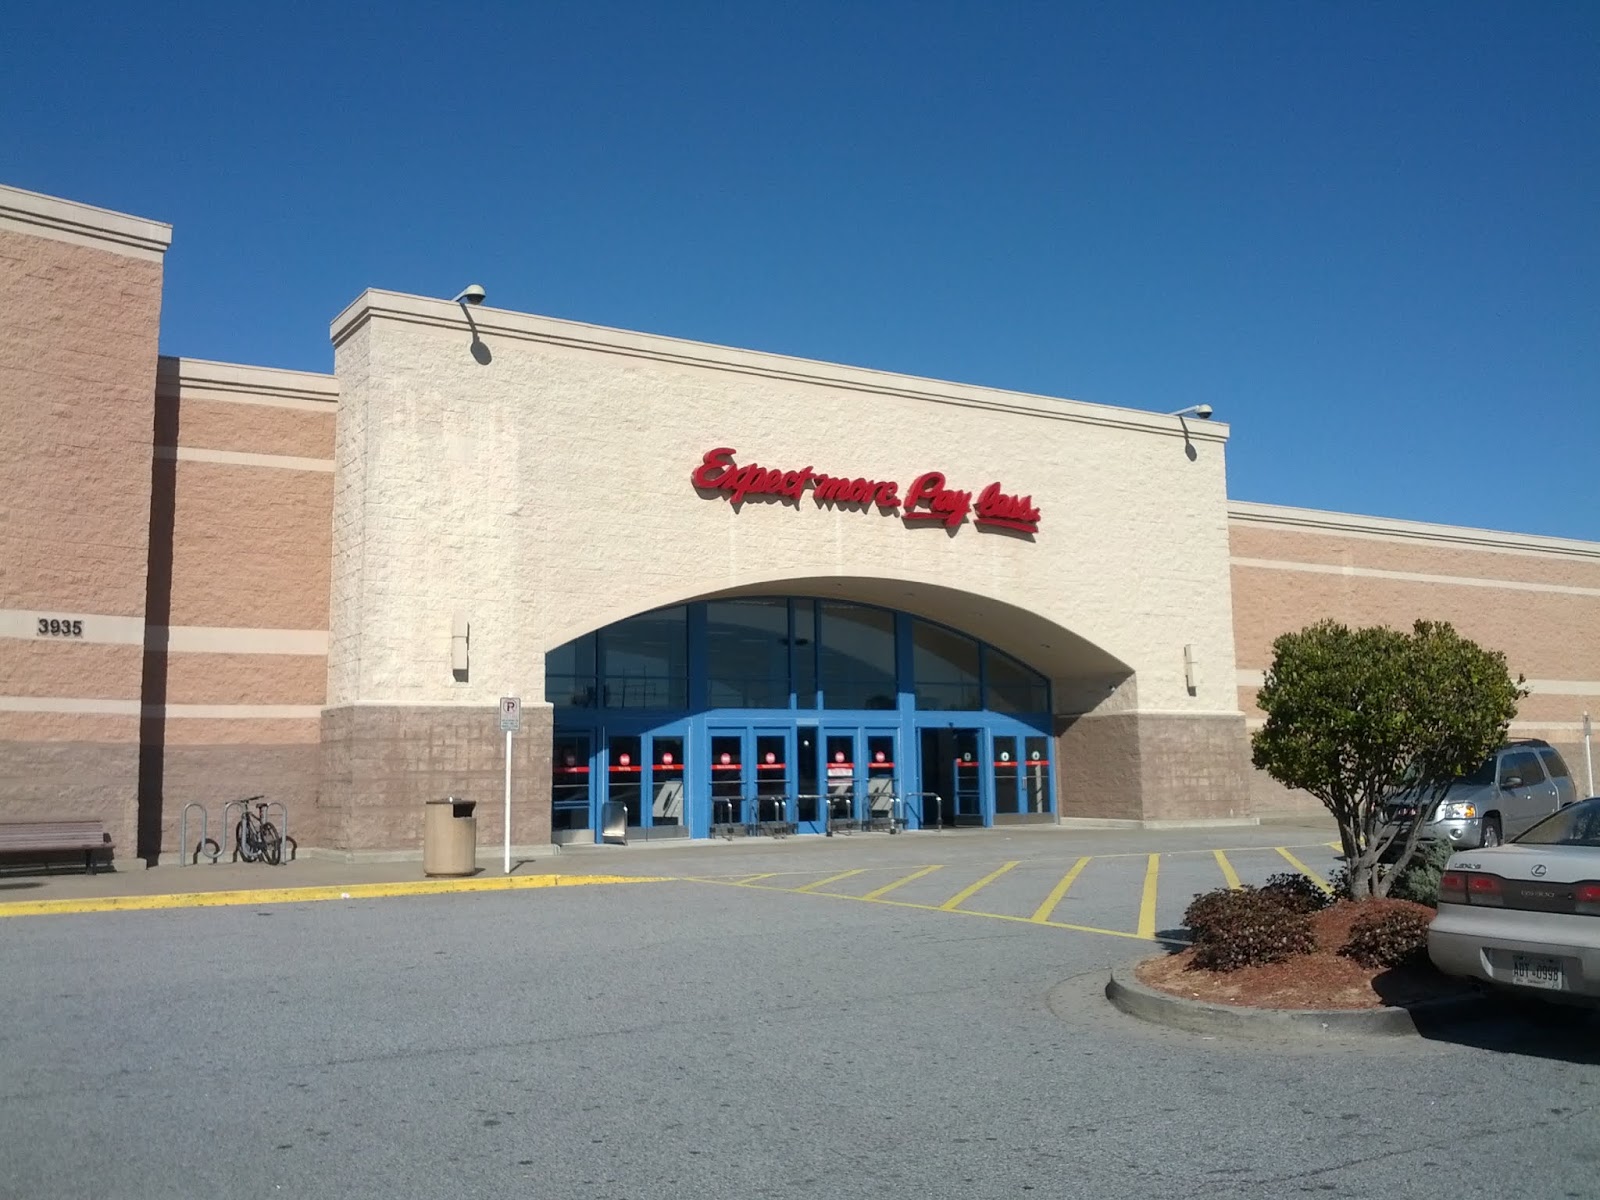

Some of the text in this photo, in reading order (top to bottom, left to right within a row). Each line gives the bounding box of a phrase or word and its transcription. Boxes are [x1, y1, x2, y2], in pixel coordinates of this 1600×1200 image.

[690, 448, 814, 504] Expect
[902, 471, 972, 526] Pay
[38, 618, 82, 636] 3935
